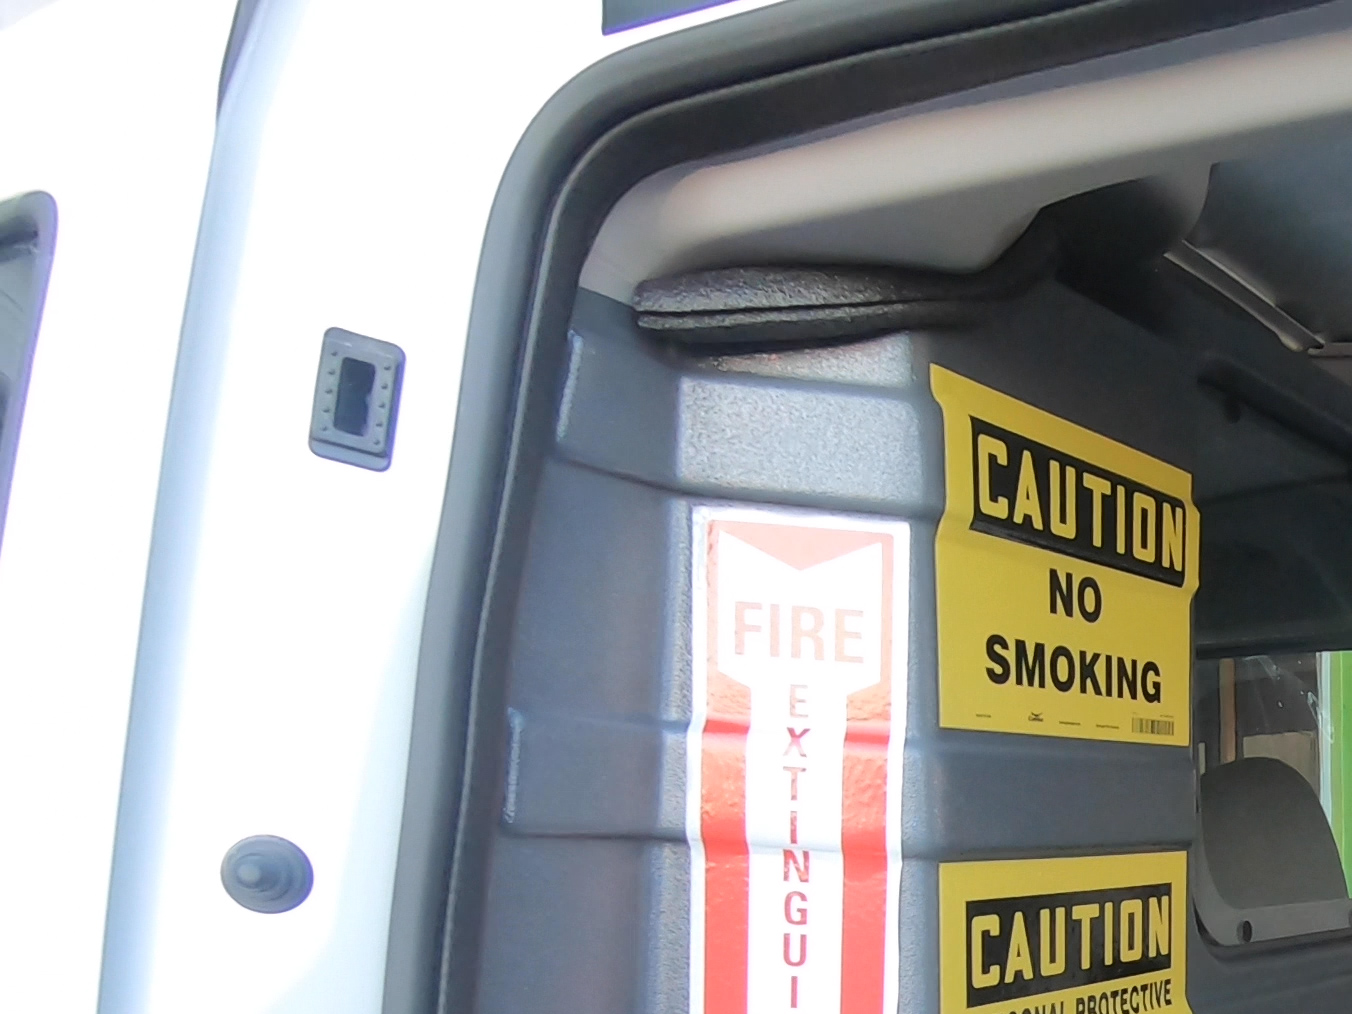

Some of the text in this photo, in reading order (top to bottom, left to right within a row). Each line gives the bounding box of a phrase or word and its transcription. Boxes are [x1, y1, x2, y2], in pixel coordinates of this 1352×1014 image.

[977, 432, 1183, 572] CAUTION
[1049, 568, 1102, 623] NO
[734, 601, 864, 663] FIRE
[985, 634, 1162, 704] SMOKING
[971, 895, 1170, 990] CAUTION
